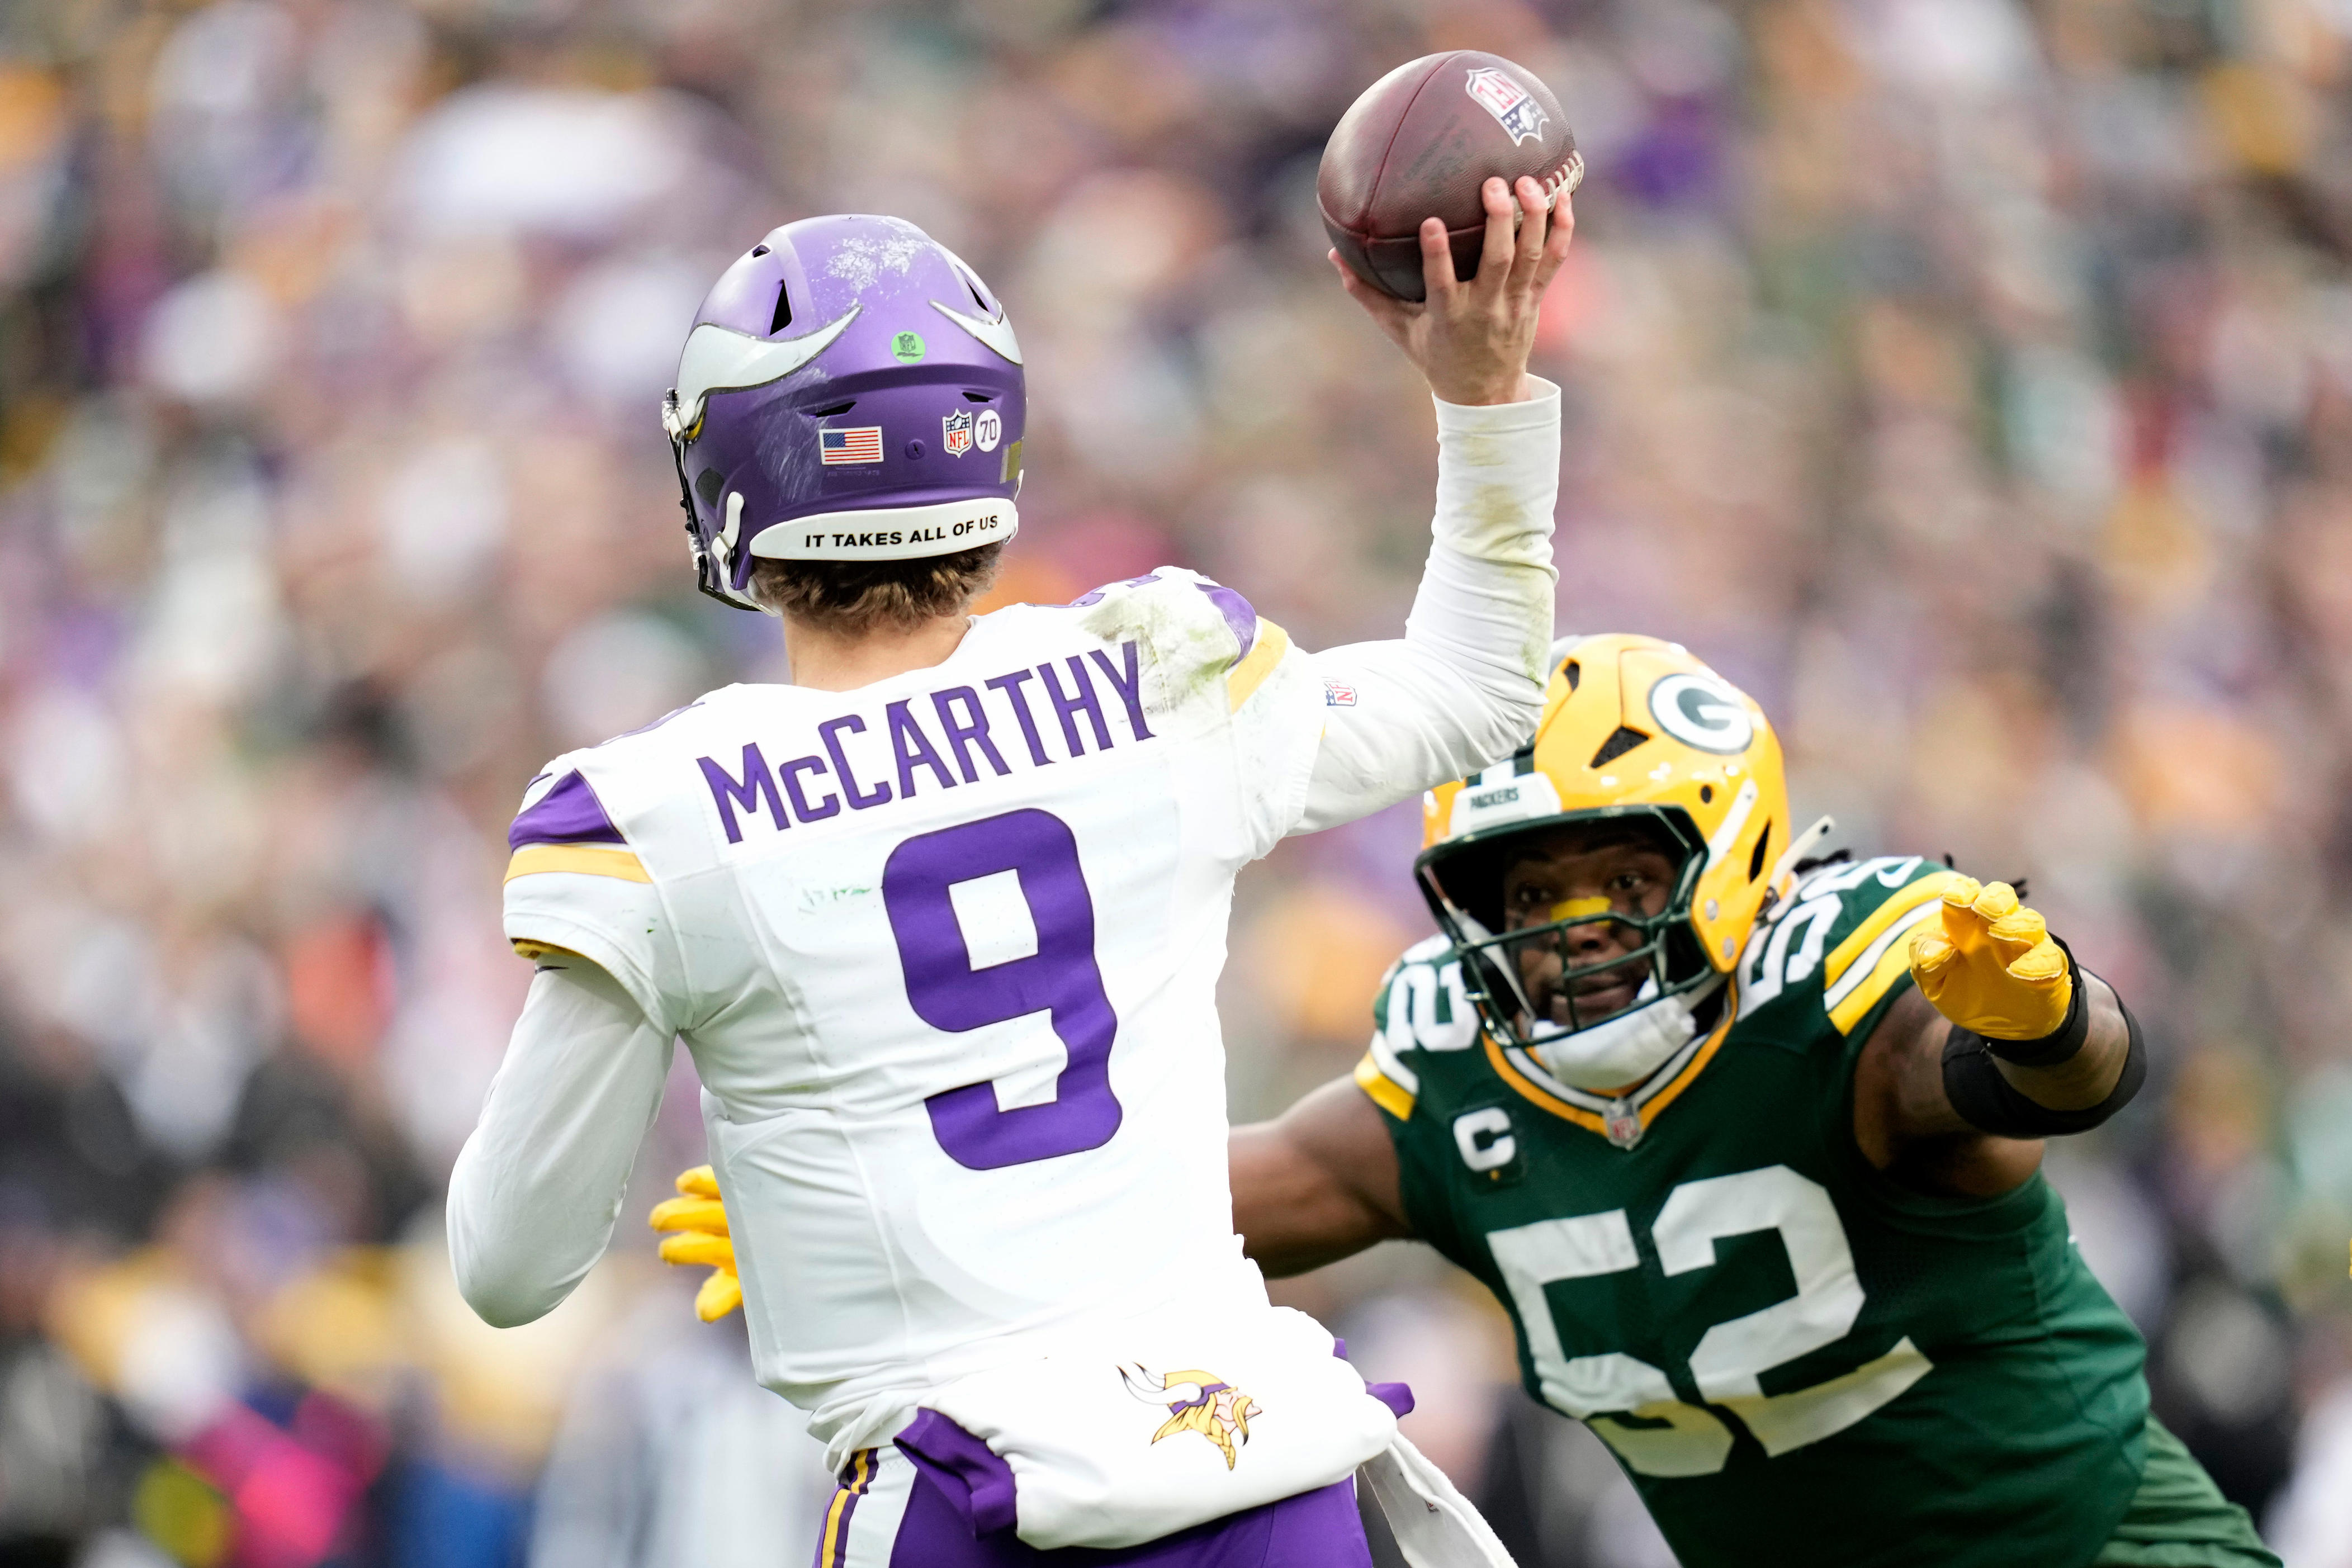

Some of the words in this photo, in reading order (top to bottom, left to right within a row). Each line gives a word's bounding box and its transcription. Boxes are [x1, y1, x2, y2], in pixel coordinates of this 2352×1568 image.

[1476, 73, 1524, 110] NFL
[949, 430, 969, 449] NFL
[979, 418, 997, 443] 70
[806, 534, 825, 547] IT
[832, 532, 902, 547] TAKES
[909, 527, 946, 543] ALL
[953, 520, 974, 536] OF
[979, 515, 998, 530] US
[696, 639, 1157, 844] McCARTHY
[1646, 673, 1754, 755] G
[882, 808, 1123, 1171] 9
[1454, 1106, 1516, 1173] C
[1486, 1163, 1934, 1478] 52
